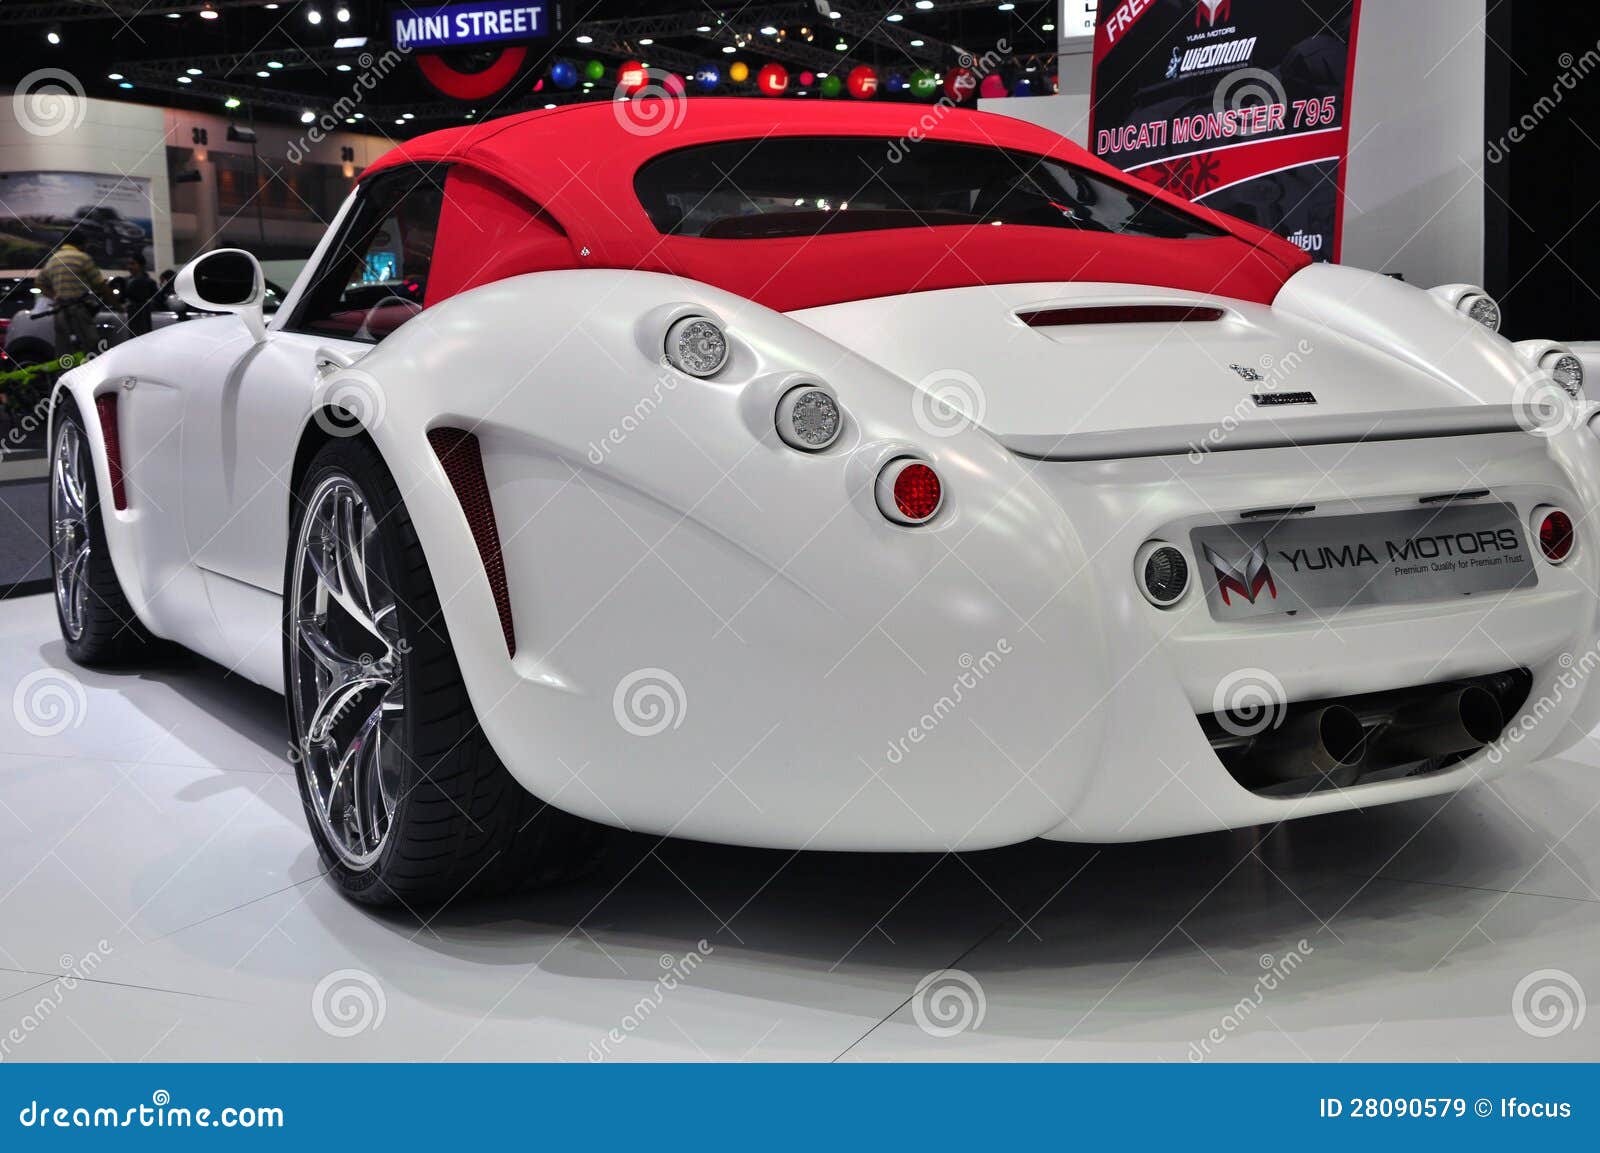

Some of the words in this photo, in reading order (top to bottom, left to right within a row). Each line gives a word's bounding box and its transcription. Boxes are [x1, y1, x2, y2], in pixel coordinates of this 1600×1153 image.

[396, 15, 449, 42] MINI
[455, 7, 541, 38] STREET
[1106, 0, 1151, 42] FRE
[1187, 33, 1206, 42] YUMA
[1207, 26, 1236, 38] MOTORS
[1097, 119, 1167, 155] DUCATI
[1172, 102, 1286, 144] MONSTER
[1292, 96, 1336, 126] 795
[1279, 543, 1380, 573] YUMA
[1385, 528, 1519, 562] MOTORS
[1394, 564, 1429, 576] Premium
[1431, 559, 1456, 572] Quality
[1458, 559, 1469, 569] for
[1470, 556, 1502, 568] Premium
